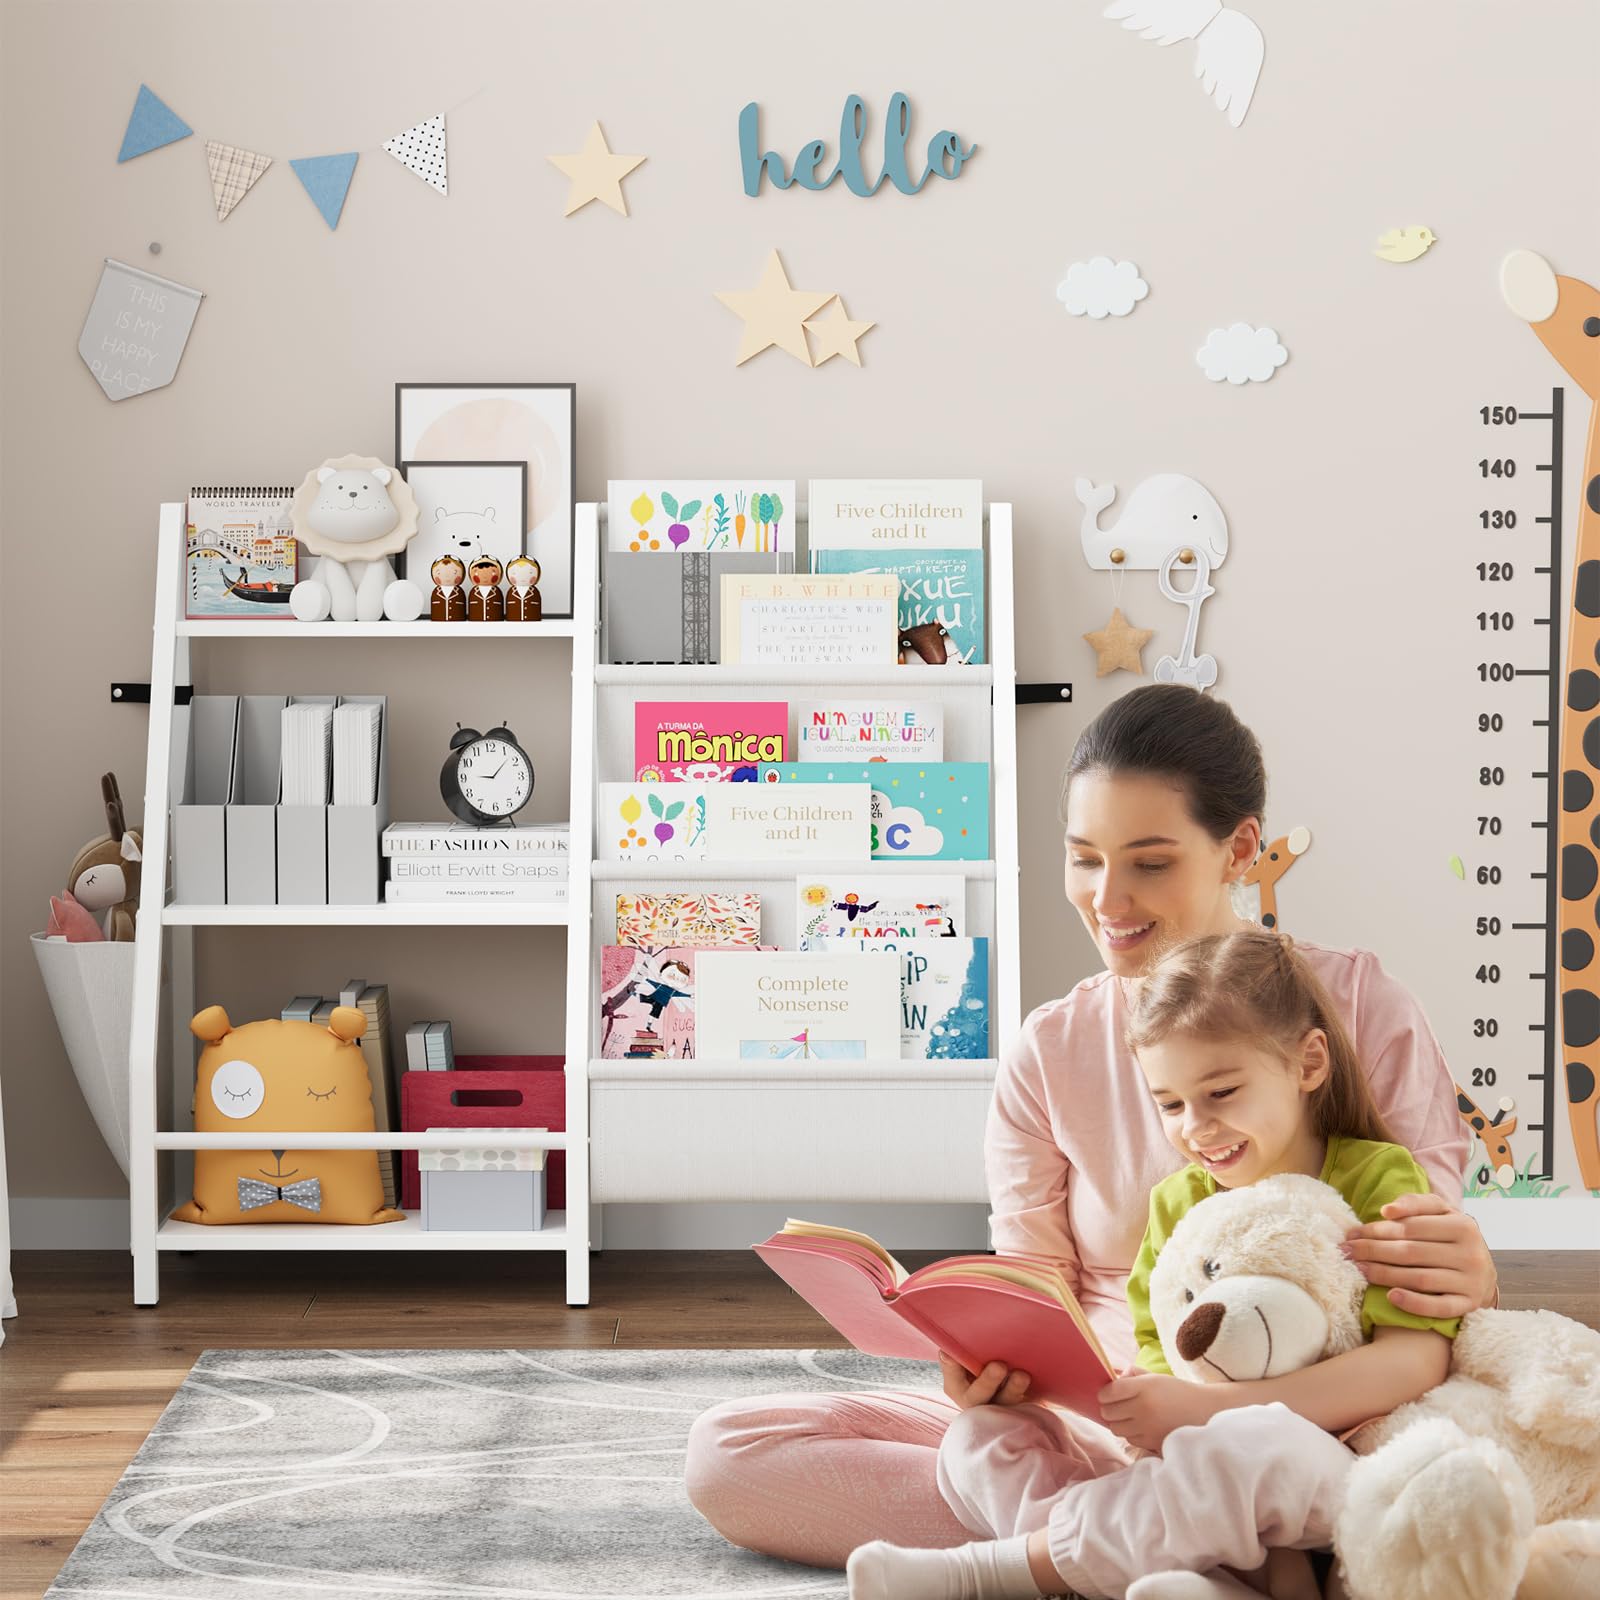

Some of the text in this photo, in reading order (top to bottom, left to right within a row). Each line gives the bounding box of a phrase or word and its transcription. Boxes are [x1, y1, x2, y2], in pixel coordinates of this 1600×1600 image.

[738, 91, 978, 198] hello
[130, 284, 169, 313] THIS
[115, 311, 163, 341] IS MY
[102, 335, 161, 368] HAPPY
[1479, 405, 1517, 425] 150
[1478, 458, 1516, 478] 140
[836, 502, 964, 519] Five Children
[1479, 509, 1516, 529] 130
[871, 524, 927, 539] and It
[1476, 562, 1513, 581] 120
[801, 585, 897, 597] WHITE
[1476, 611, 1514, 631] 110
[1477, 662, 1514, 682] 100
[657, 722, 704, 730] A TURMA DA
[1478, 713, 1503, 732] 90
[473, 747, 480, 756] 11
[486, 743, 496, 752] 12
[503, 746, 506, 756] 1
[463, 758, 473, 768] 10
[512, 757, 518, 767] 2
[460, 773, 467, 783] 9
[518, 771, 524, 781] 3
[1479, 766, 1504, 785] 80
[466, 788, 473, 798] 8
[478, 799, 484, 809] 7
[493, 803, 499, 811] 6
[507, 798, 513, 808] 5
[731, 806, 853, 820] Five Children
[766, 826, 818, 839] and It
[1477, 816, 1502, 835] 70
[386, 839, 568, 850] THE FASHION BOOK
[397, 863, 559, 879] Elliott Erwitt Snaps
[1476, 866, 1501, 885] 60
[1476, 917, 1501, 936] 50
[1475, 964, 1500, 983] 40
[758, 976, 848, 995] Complete
[758, 997, 848, 1012] Nonsense
[1473, 1018, 1498, 1037] 30
[1472, 1067, 1496, 1086] 20
